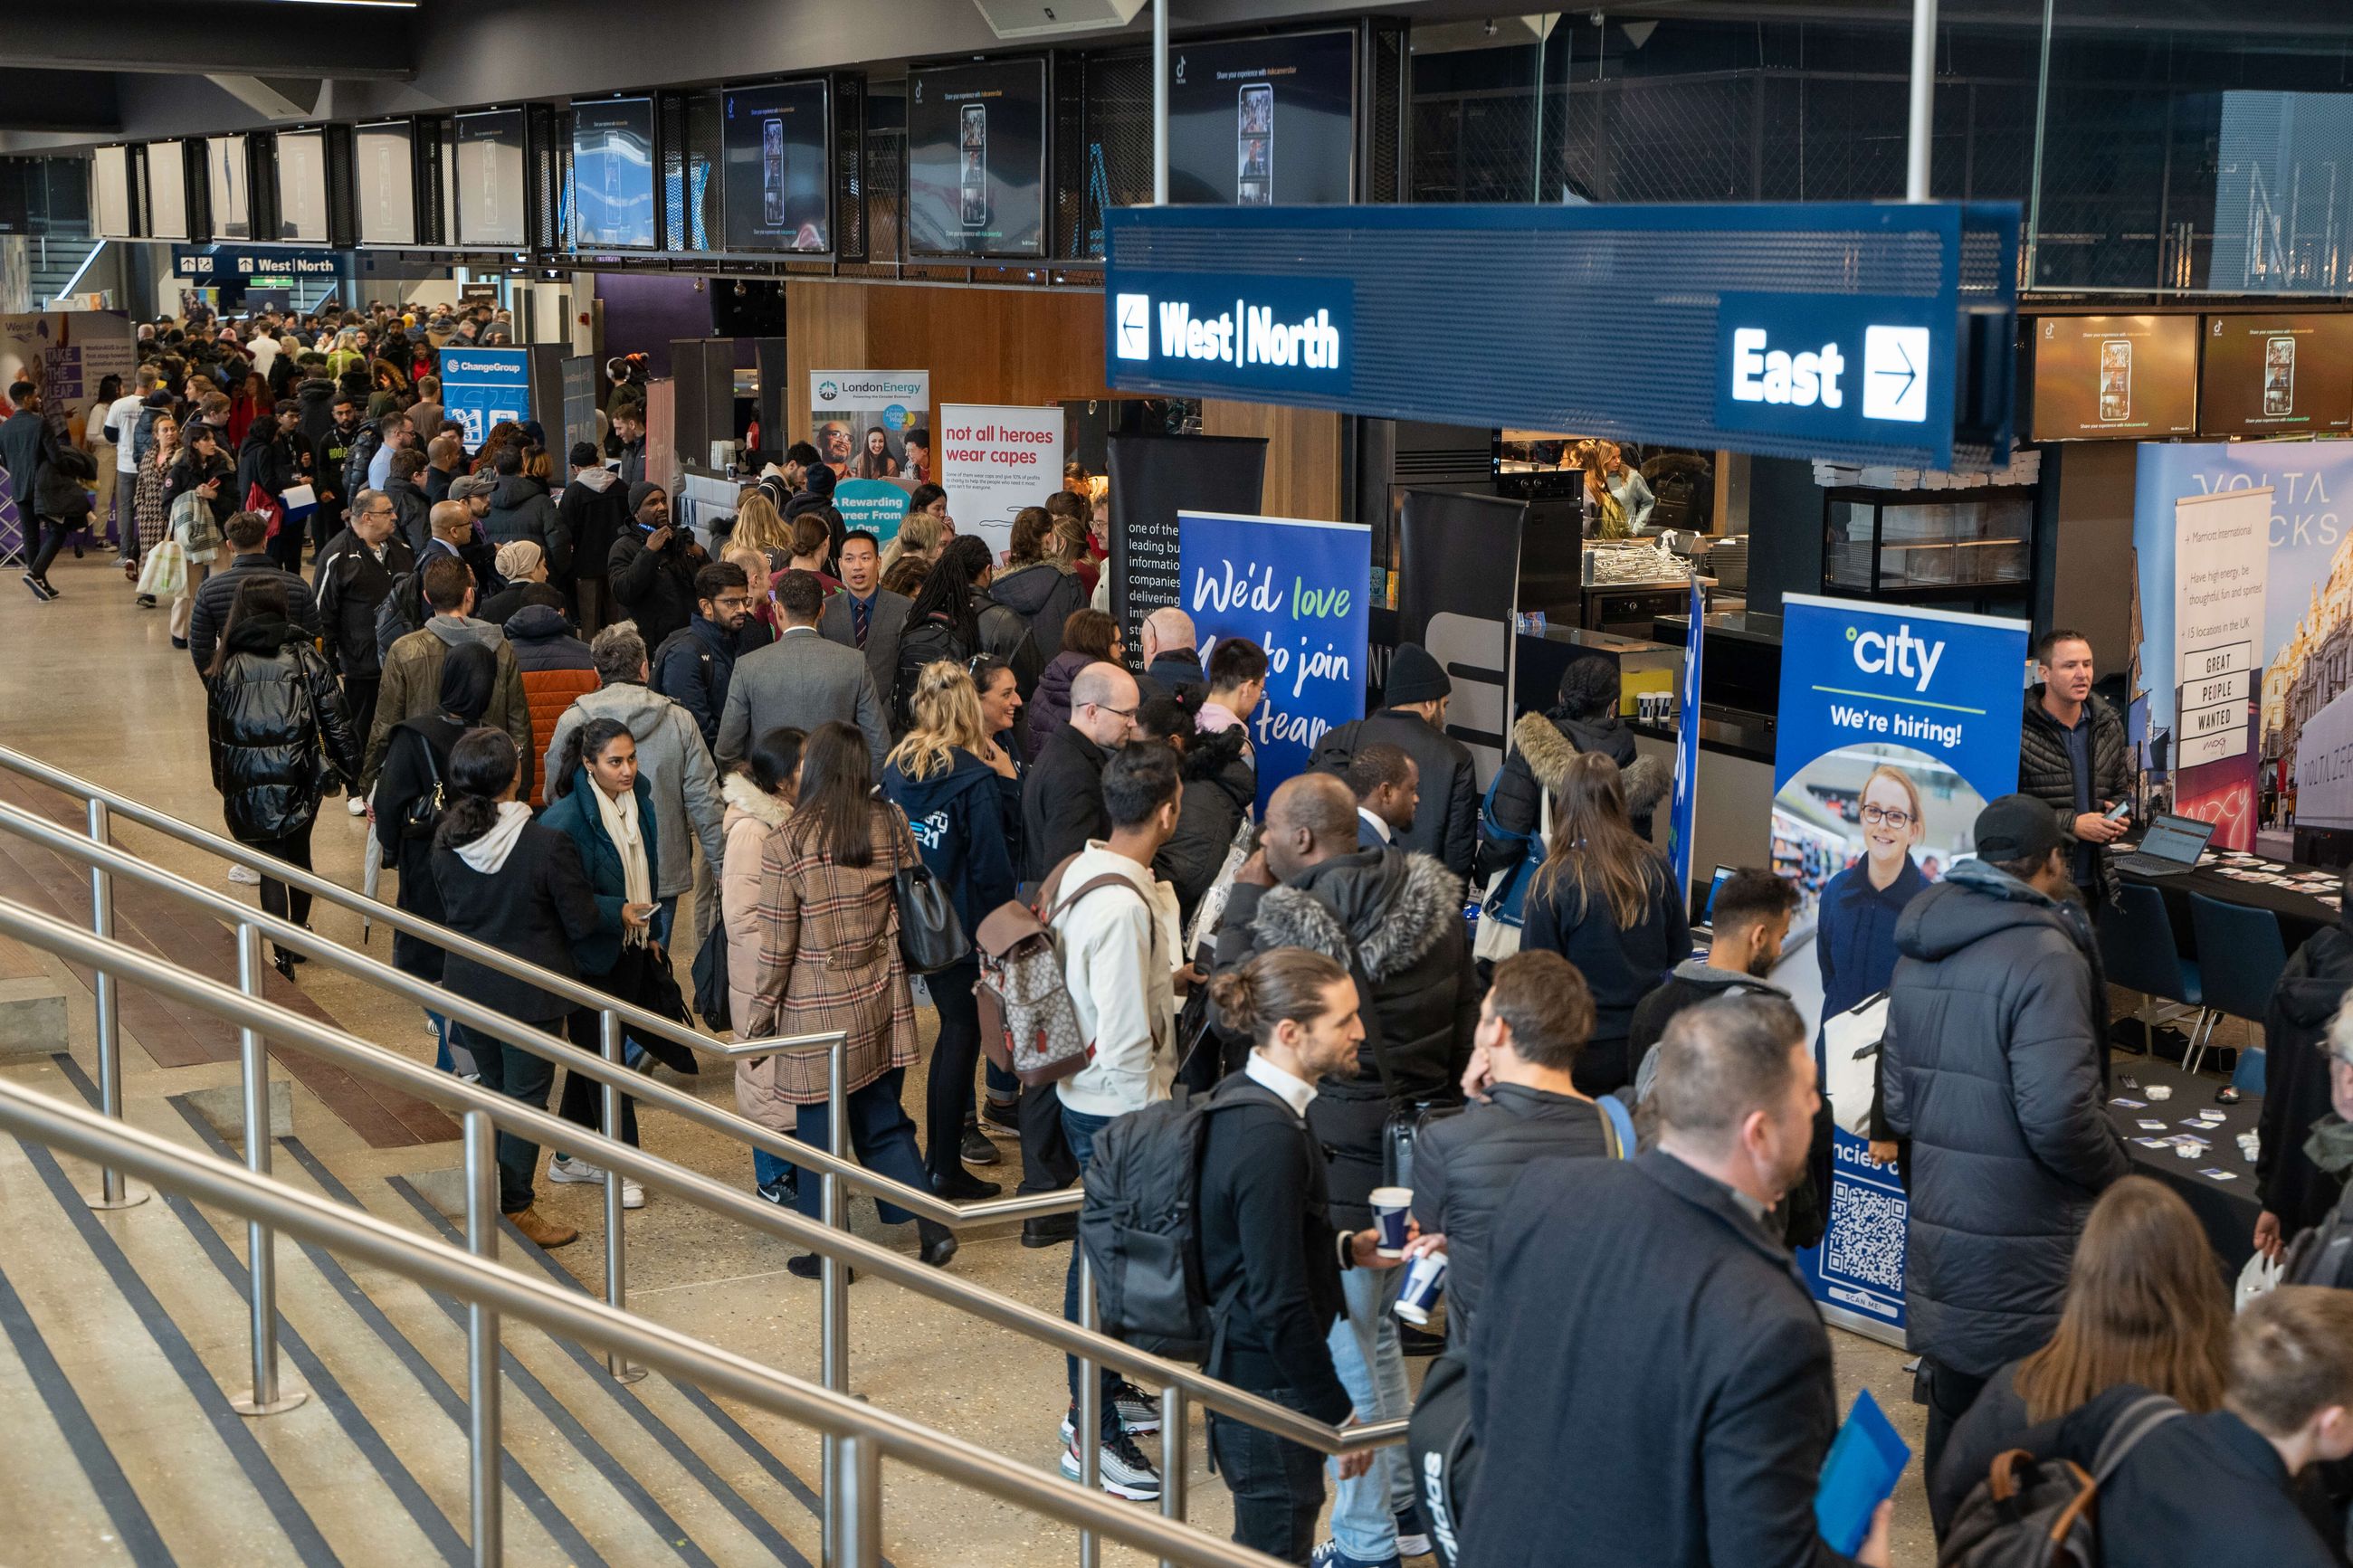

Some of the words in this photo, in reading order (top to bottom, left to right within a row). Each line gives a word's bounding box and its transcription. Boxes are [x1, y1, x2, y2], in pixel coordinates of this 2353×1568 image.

[1216, 71, 1228, 80] Share
[1228, 71, 1237, 81] your
[1237, 70, 1258, 79] experience
[258, 258, 291, 271] West
[297, 259, 334, 271] North
[1158, 300, 1234, 362] West
[1246, 305, 1340, 369] North
[46, 348, 72, 362] TAKE
[47, 366, 69, 380] THE
[461, 362, 520, 374] ChangeGroup
[1732, 327, 1845, 410] East
[49, 385, 73, 398] LEAP
[843, 382, 920, 394] LondonEnergy
[946, 426, 972, 441] not
[976, 425, 995, 442] all
[999, 425, 1053, 443] heroes
[946, 449, 986, 461] wear
[990, 451, 1037, 467] capes
[832, 498, 839, 507] A
[842, 497, 903, 508] Rewarding
[842, 511, 869, 520] areer
[872, 510, 901, 519] From
[856, 524, 880, 533] One
[1129, 523, 1147, 534] one
[1149, 523, 1159, 536] of
[1162, 524, 1179, 537] the
[2192, 530, 2217, 544] Marriott
[2268, 513, 2339, 547] CKS
[1129, 537, 1165, 556] leading
[1129, 556, 1180, 572] informatio
[1129, 574, 1181, 589] companies
[2191, 573, 2206, 584] Have
[2208, 571, 2219, 584] high
[2241, 565, 2249, 576] be
[1129, 589, 1180, 608] delivering
[1193, 559, 1283, 613] We'd
[1292, 575, 1351, 621] love
[2221, 588, 2230, 600] fun
[2231, 586, 2242, 599] and
[2243, 583, 2262, 597] spirited
[2187, 626, 2195, 639] 15
[2196, 625, 2222, 638] locations
[2229, 620, 2239, 632] the
[2240, 616, 2250, 630] UK
[1292, 636, 1349, 698] join
[1853, 624, 1946, 692] city
[2206, 653, 2231, 673] GREAT
[2202, 680, 2232, 702] PEOPLE
[1830, 705, 1889, 733] We’re
[1894, 713, 1962, 748] hiring!
[2198, 708, 2231, 731] WANTED
[2304, 753, 2330, 787] VOLTA
[923, 827, 939, 850] 21
[1845, 1293, 1866, 1307] SCAN
[1867, 1299, 1882, 1312] ME!
[1424, 1451, 1459, 1567] didas
